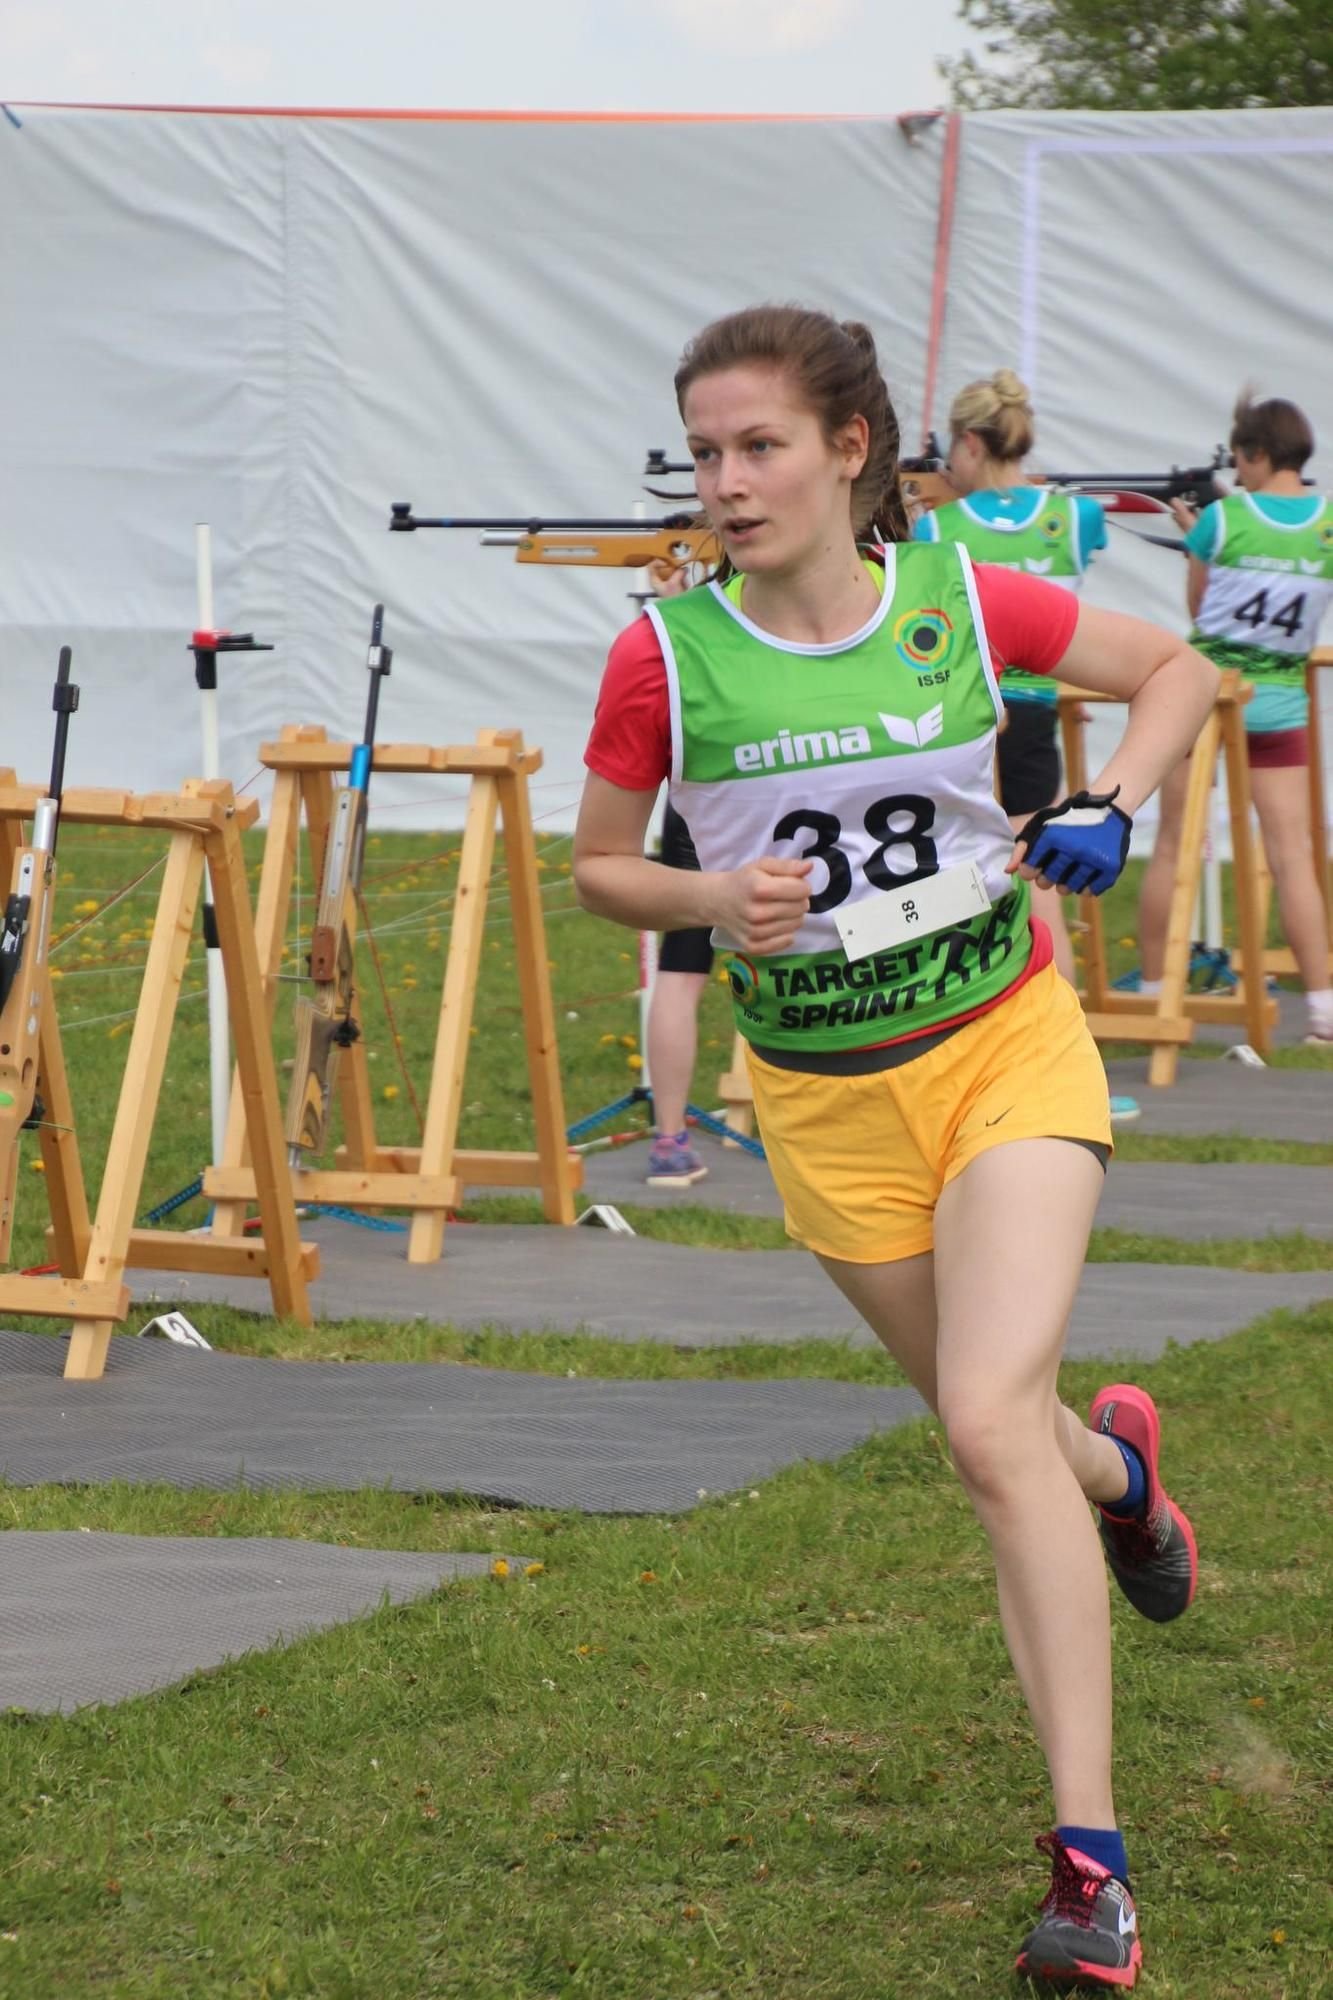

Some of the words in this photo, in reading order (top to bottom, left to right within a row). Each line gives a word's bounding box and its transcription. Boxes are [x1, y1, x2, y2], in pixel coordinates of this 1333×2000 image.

[1233, 588, 1307, 637] 44
[734, 726, 872, 772] erima
[773, 794, 940, 914] 38
[901, 899, 919, 924] 38
[768, 945, 924, 998] TARGET
[778, 979, 928, 1030] SPRINT
